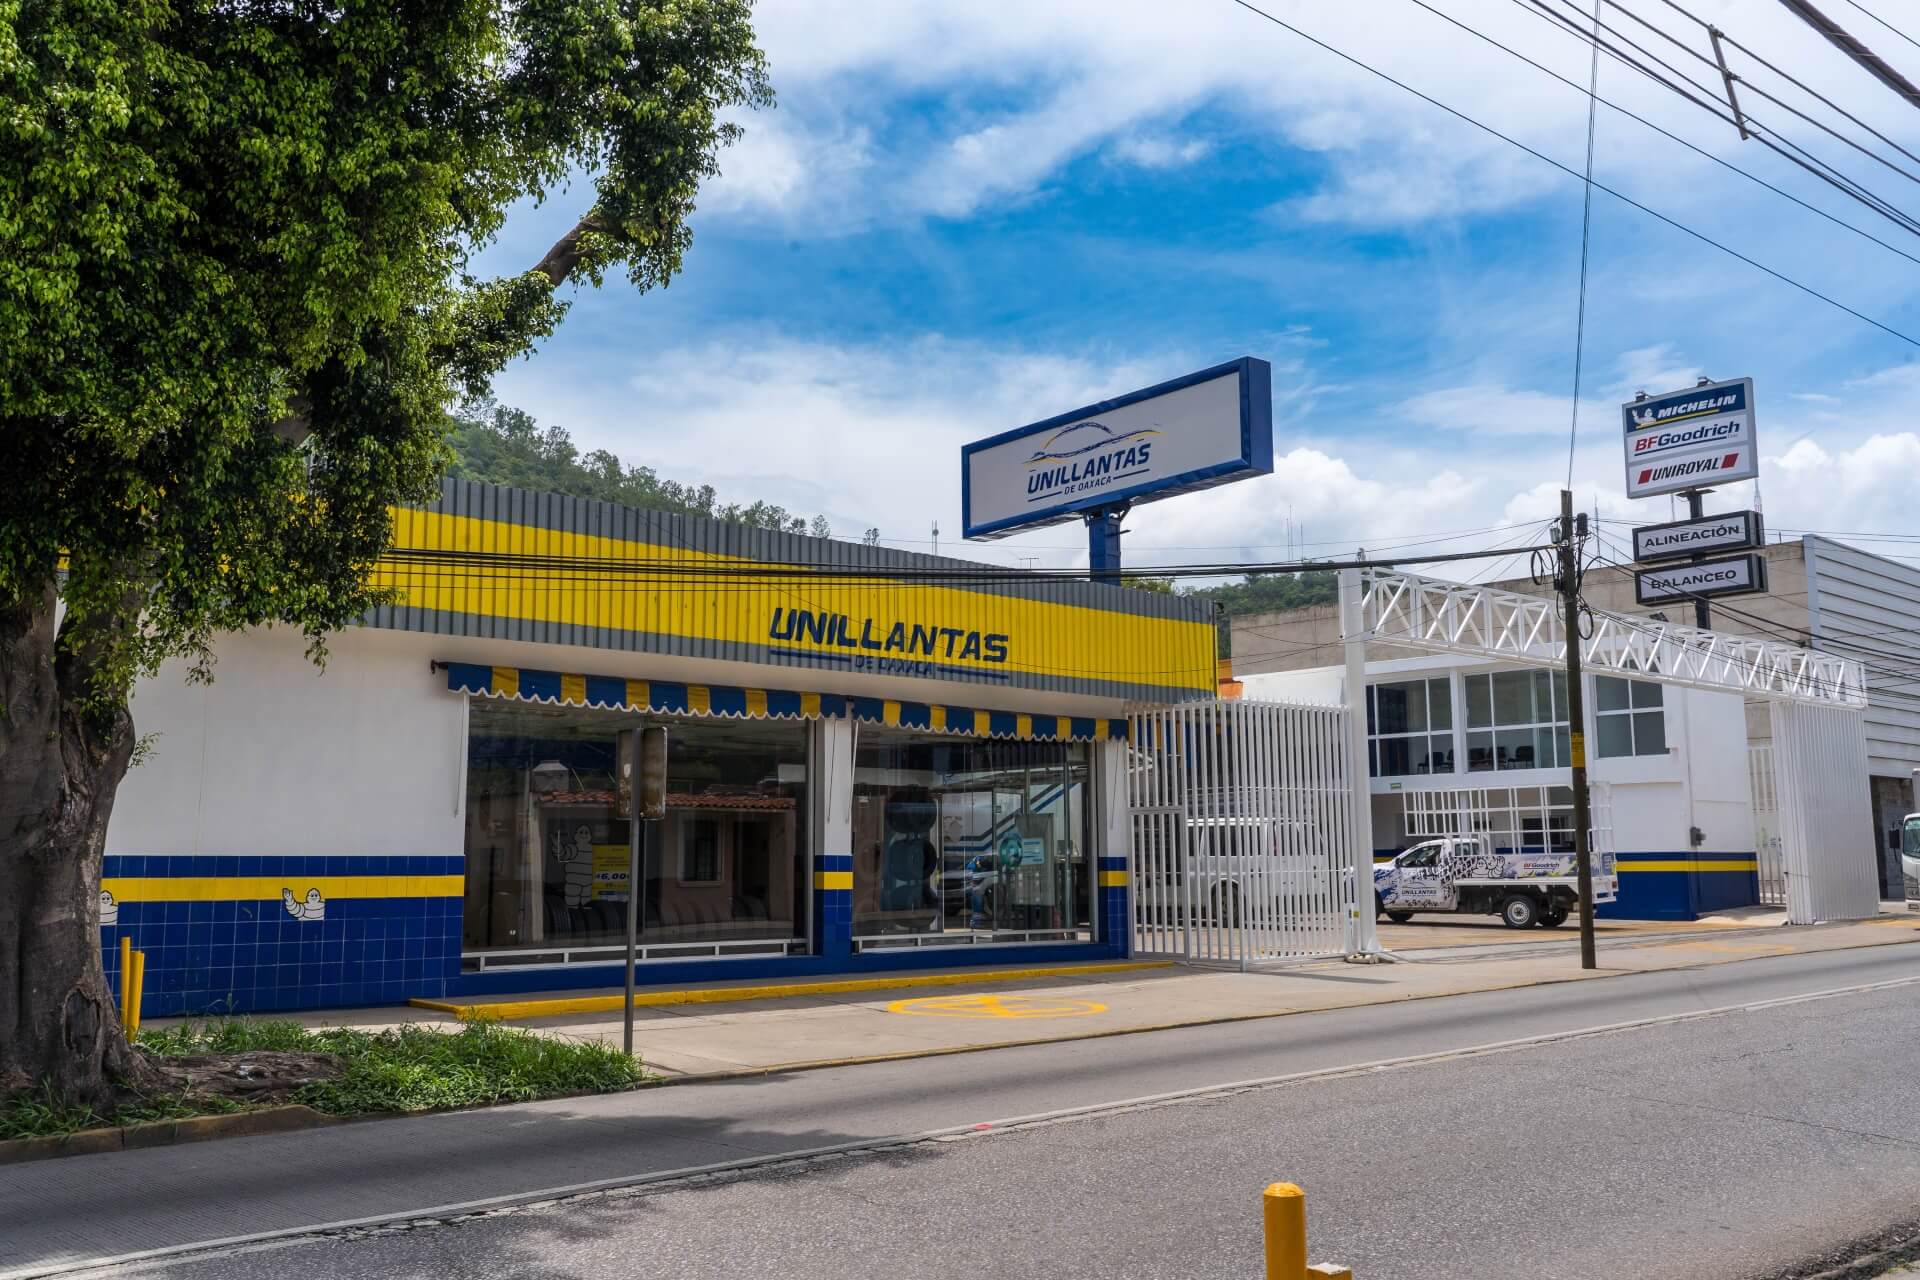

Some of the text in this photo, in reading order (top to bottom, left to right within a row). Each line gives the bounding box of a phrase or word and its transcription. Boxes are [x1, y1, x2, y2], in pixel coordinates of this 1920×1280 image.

[1657, 394, 1737, 419] MICHELIN
[1635, 421, 1740, 451] BFGoodrich
[1027, 442, 1152, 494] UNILLANTAS
[1652, 457, 1720, 481] UNIROYAL
[1064, 475, 1112, 495] DE OAXACA
[1644, 524, 1740, 548] ALINEACIÓN
[1651, 569, 1737, 589] BALANCEO
[769, 607, 1009, 663] UNILLANTAS
[855, 655, 873, 670] DE
